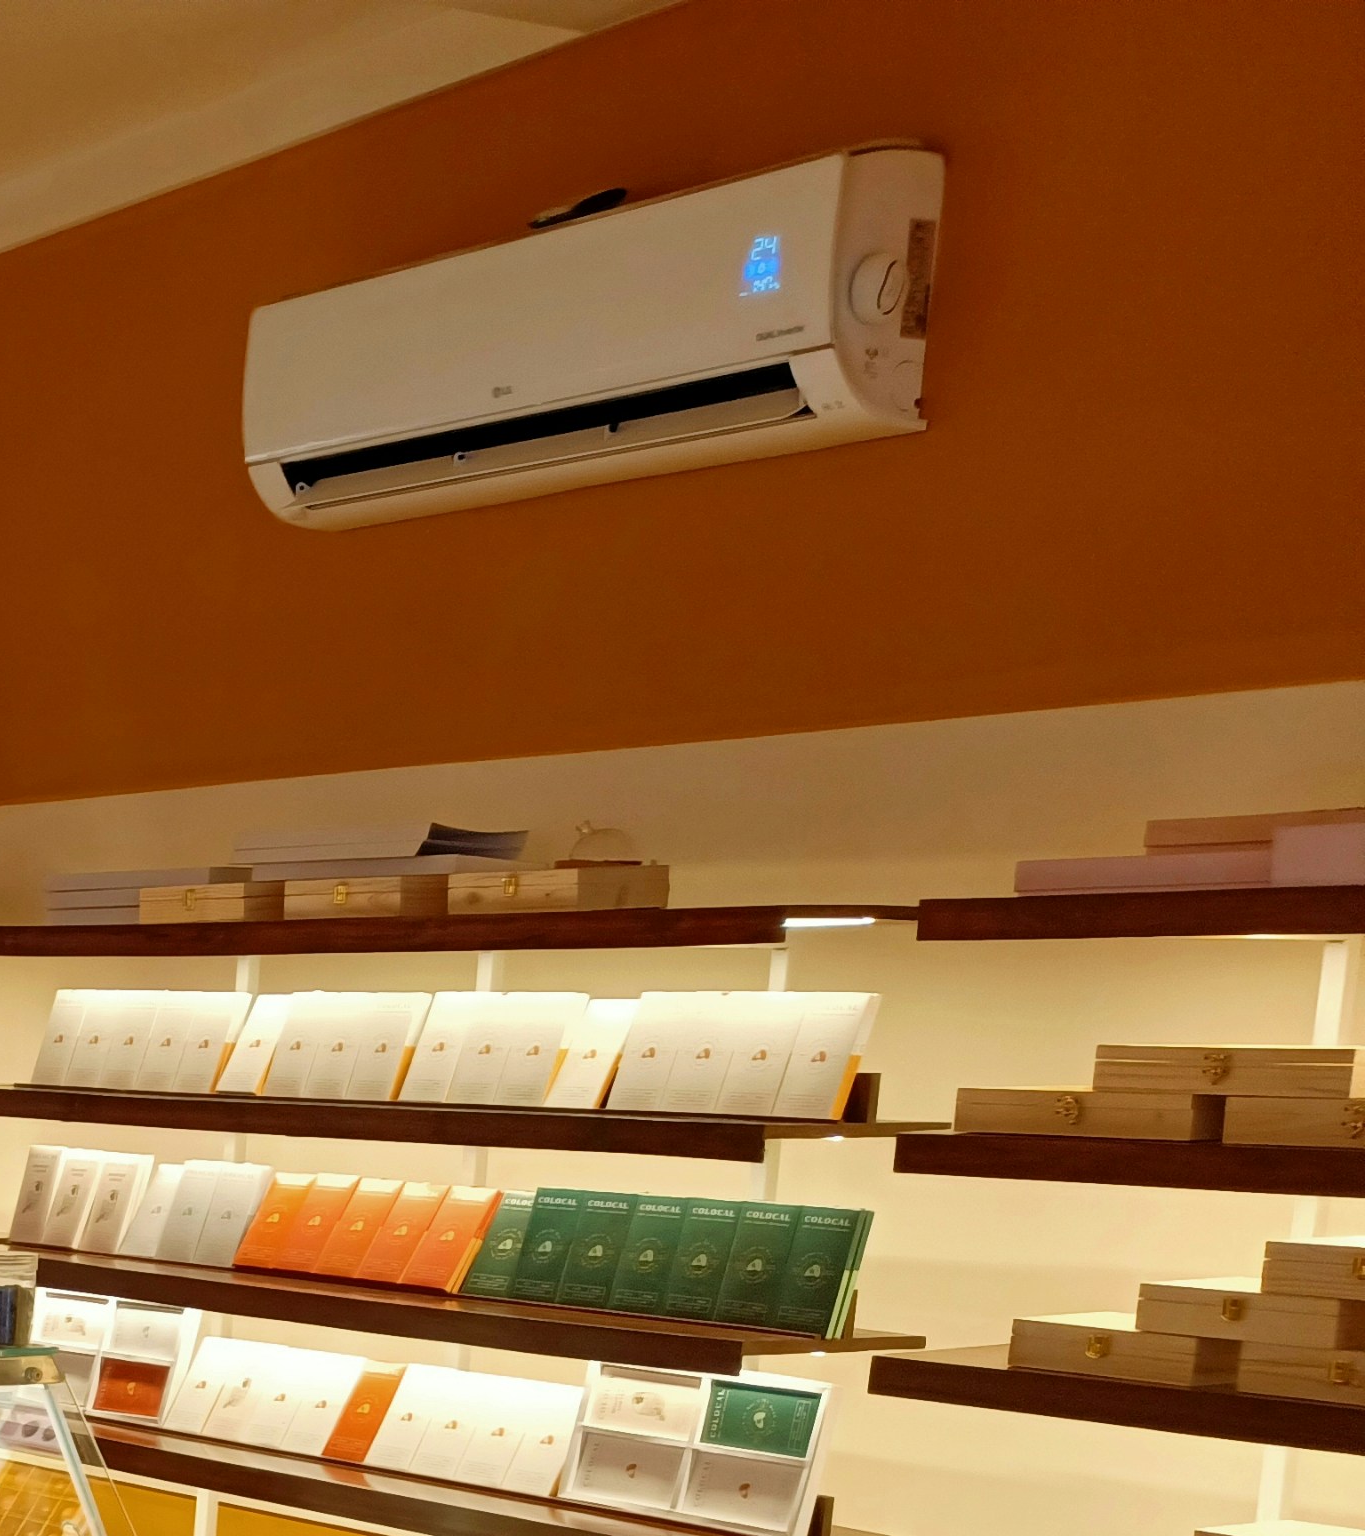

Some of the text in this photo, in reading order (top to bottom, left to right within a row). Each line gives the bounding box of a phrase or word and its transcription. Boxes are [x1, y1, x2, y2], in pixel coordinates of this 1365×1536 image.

[751, 236, 777, 260] 24
[538, 1197, 577, 1206] COLOCAL
[587, 1200, 629, 1210] COLOCAL
[639, 1204, 681, 1213] COLOCAL
[692, 1207, 735, 1217] COLOCAL
[746, 1211, 791, 1221] COLOCAL
[804, 1215, 851, 1226] COLOCAL
